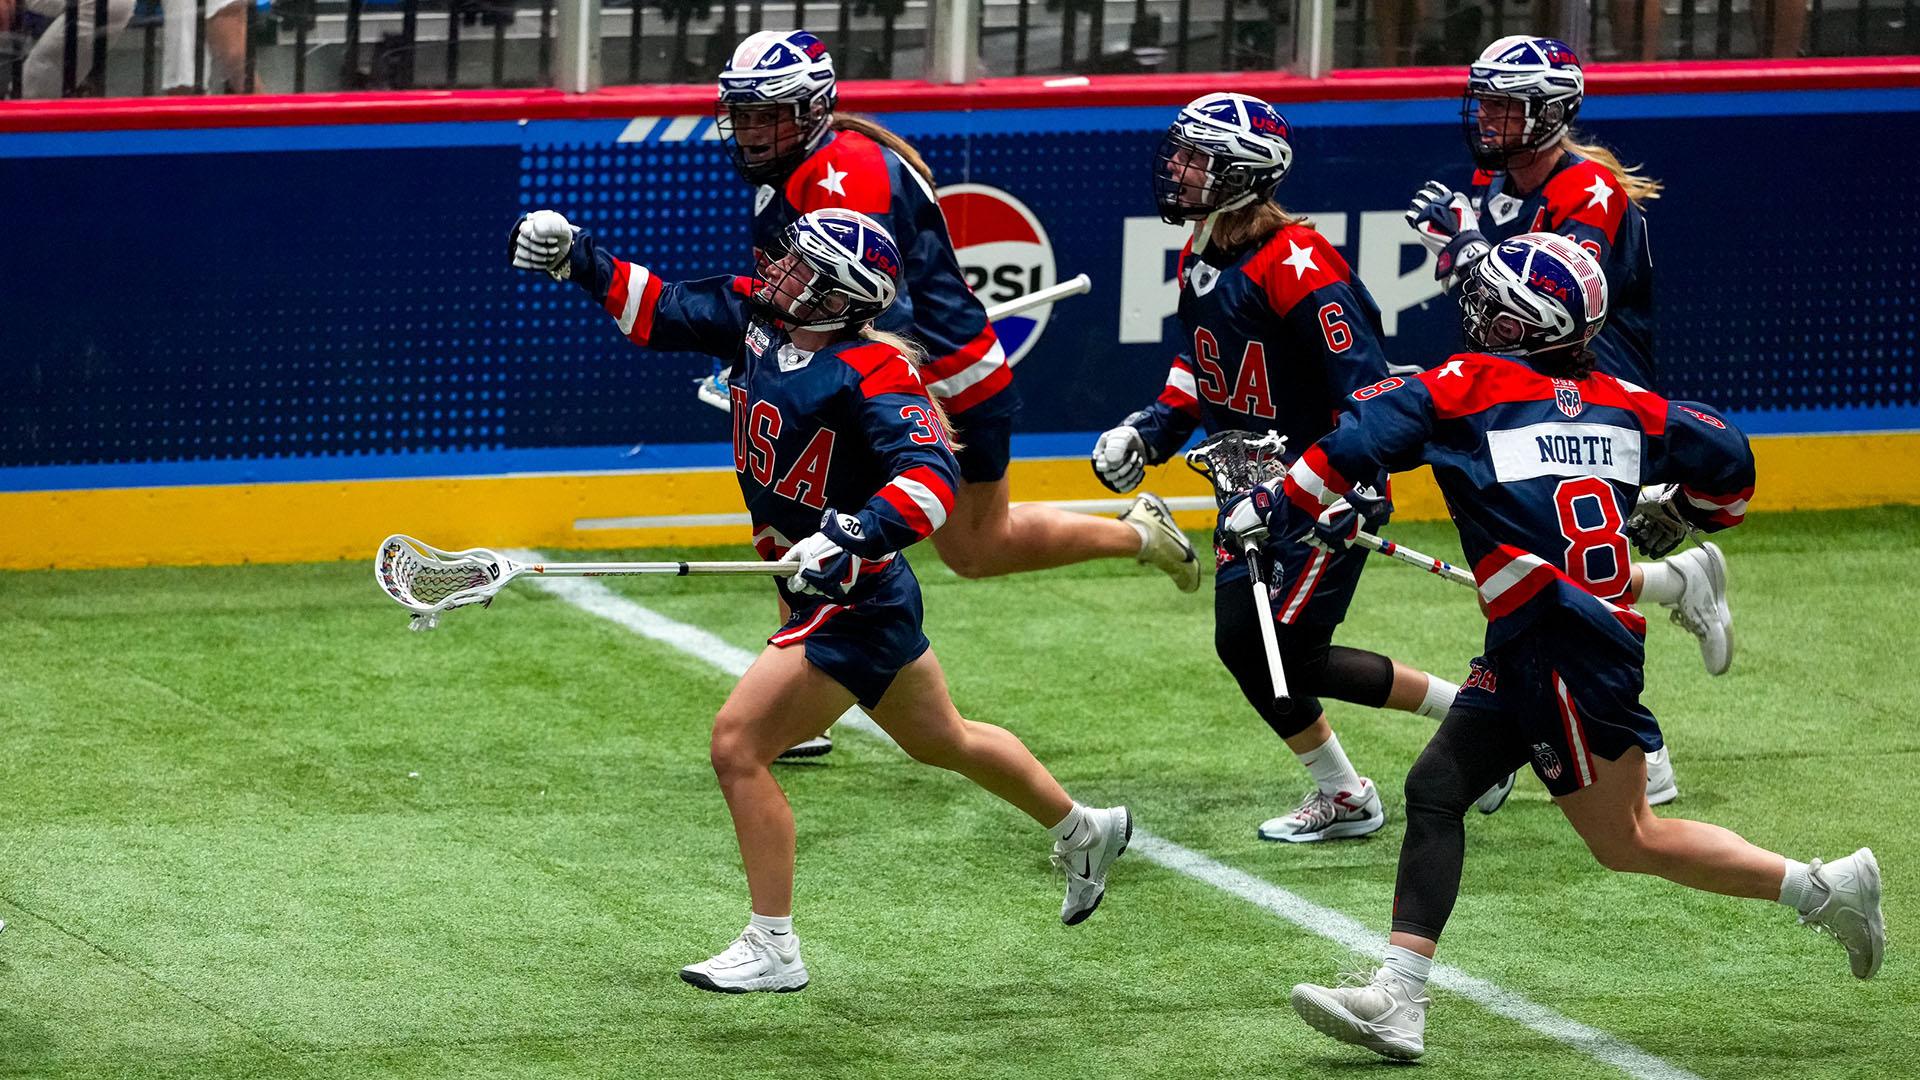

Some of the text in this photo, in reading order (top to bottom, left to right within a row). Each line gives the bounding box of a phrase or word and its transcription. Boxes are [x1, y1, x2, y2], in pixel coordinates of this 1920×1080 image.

[1252, 116, 1288, 138] USA
[865, 247, 898, 280] USA
[961, 264, 1042, 304] PSI
[1530, 271, 1567, 302] USA
[1318, 302, 1352, 354] 6
[1194, 326, 1276, 420] SA
[1352, 376, 1405, 401] 8
[730, 385, 836, 511] USA
[1535, 434, 1613, 467] NORTH
[842, 518, 862, 537] 30
[1553, 475, 1633, 600] 8
[1531, 742, 1551, 752] SA
